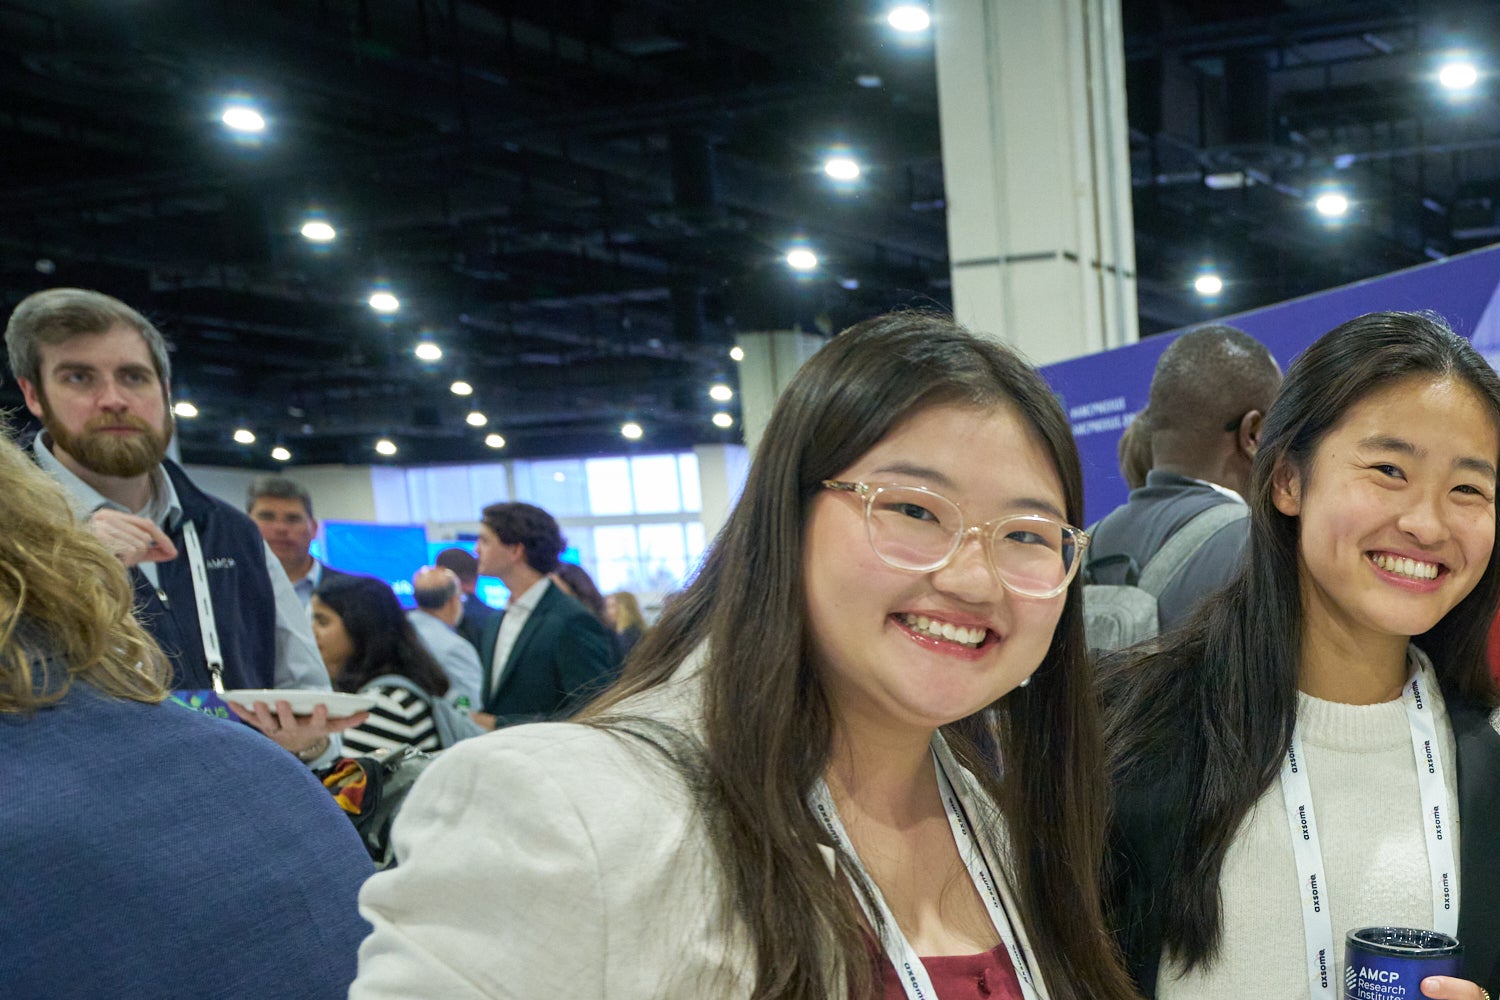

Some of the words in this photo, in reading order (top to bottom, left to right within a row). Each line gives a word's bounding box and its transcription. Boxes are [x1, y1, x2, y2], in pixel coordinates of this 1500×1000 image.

[1288, 742, 1298, 774] axsom
[1424, 740, 1435, 774] axsome
[817, 803, 842, 846] axsom
[1298, 804, 1310, 841] axsome
[1433, 805, 1443, 840] axsome
[1309, 873, 1321, 913] axsome
[1441, 872, 1450, 910] axsome
[1319, 948, 1329, 989] axsome
[1358, 978, 1406, 995] Research
[1359, 966, 1399, 983] AMCP
